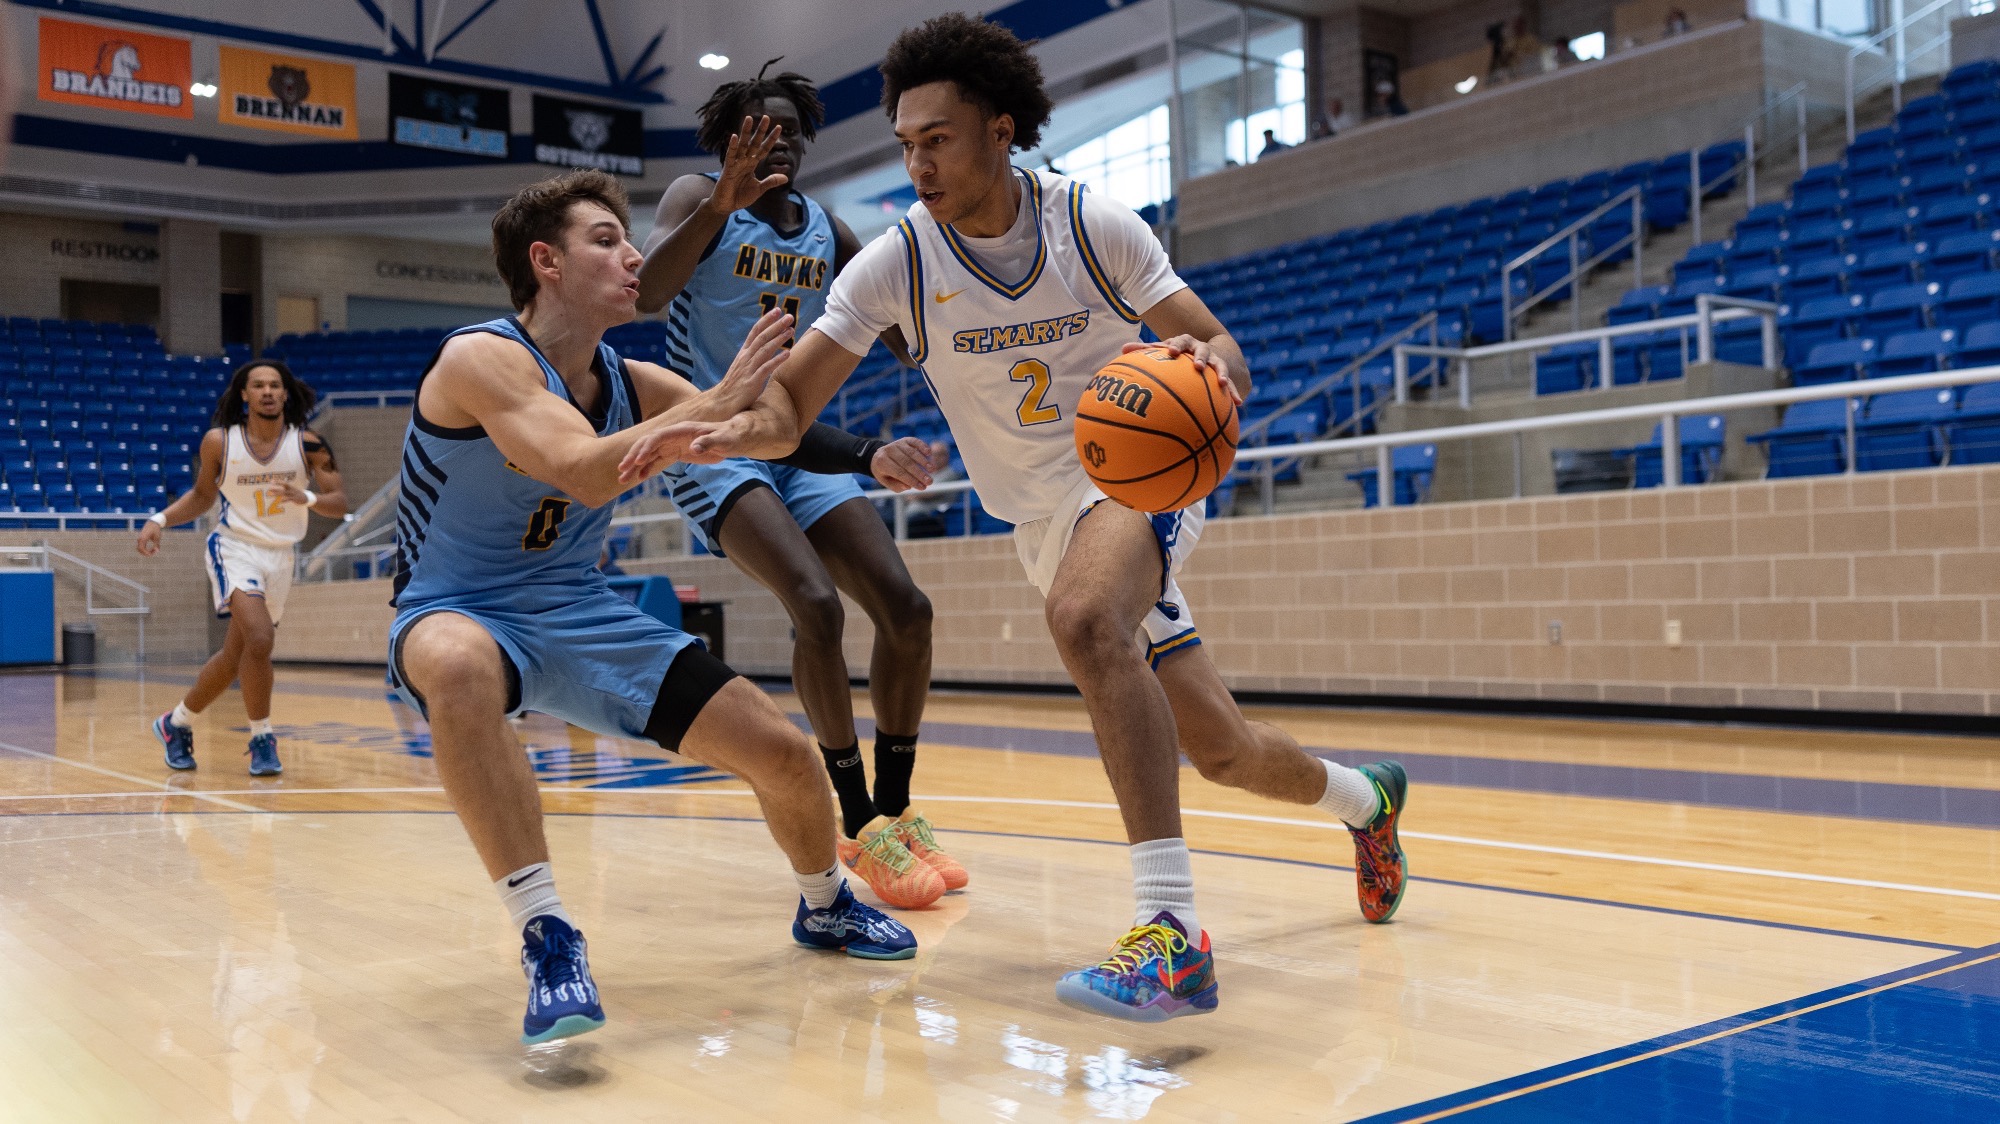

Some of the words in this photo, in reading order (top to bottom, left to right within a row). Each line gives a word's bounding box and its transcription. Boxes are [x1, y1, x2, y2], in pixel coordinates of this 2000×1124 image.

[52, 68, 183, 108] BRANDEIS
[235, 93, 344, 128] BRENNAN
[733, 243, 829, 292] HAWKS
[1008, 357, 1062, 427] 2
[252, 487, 286, 518] 12
[521, 496, 572, 552] 0
